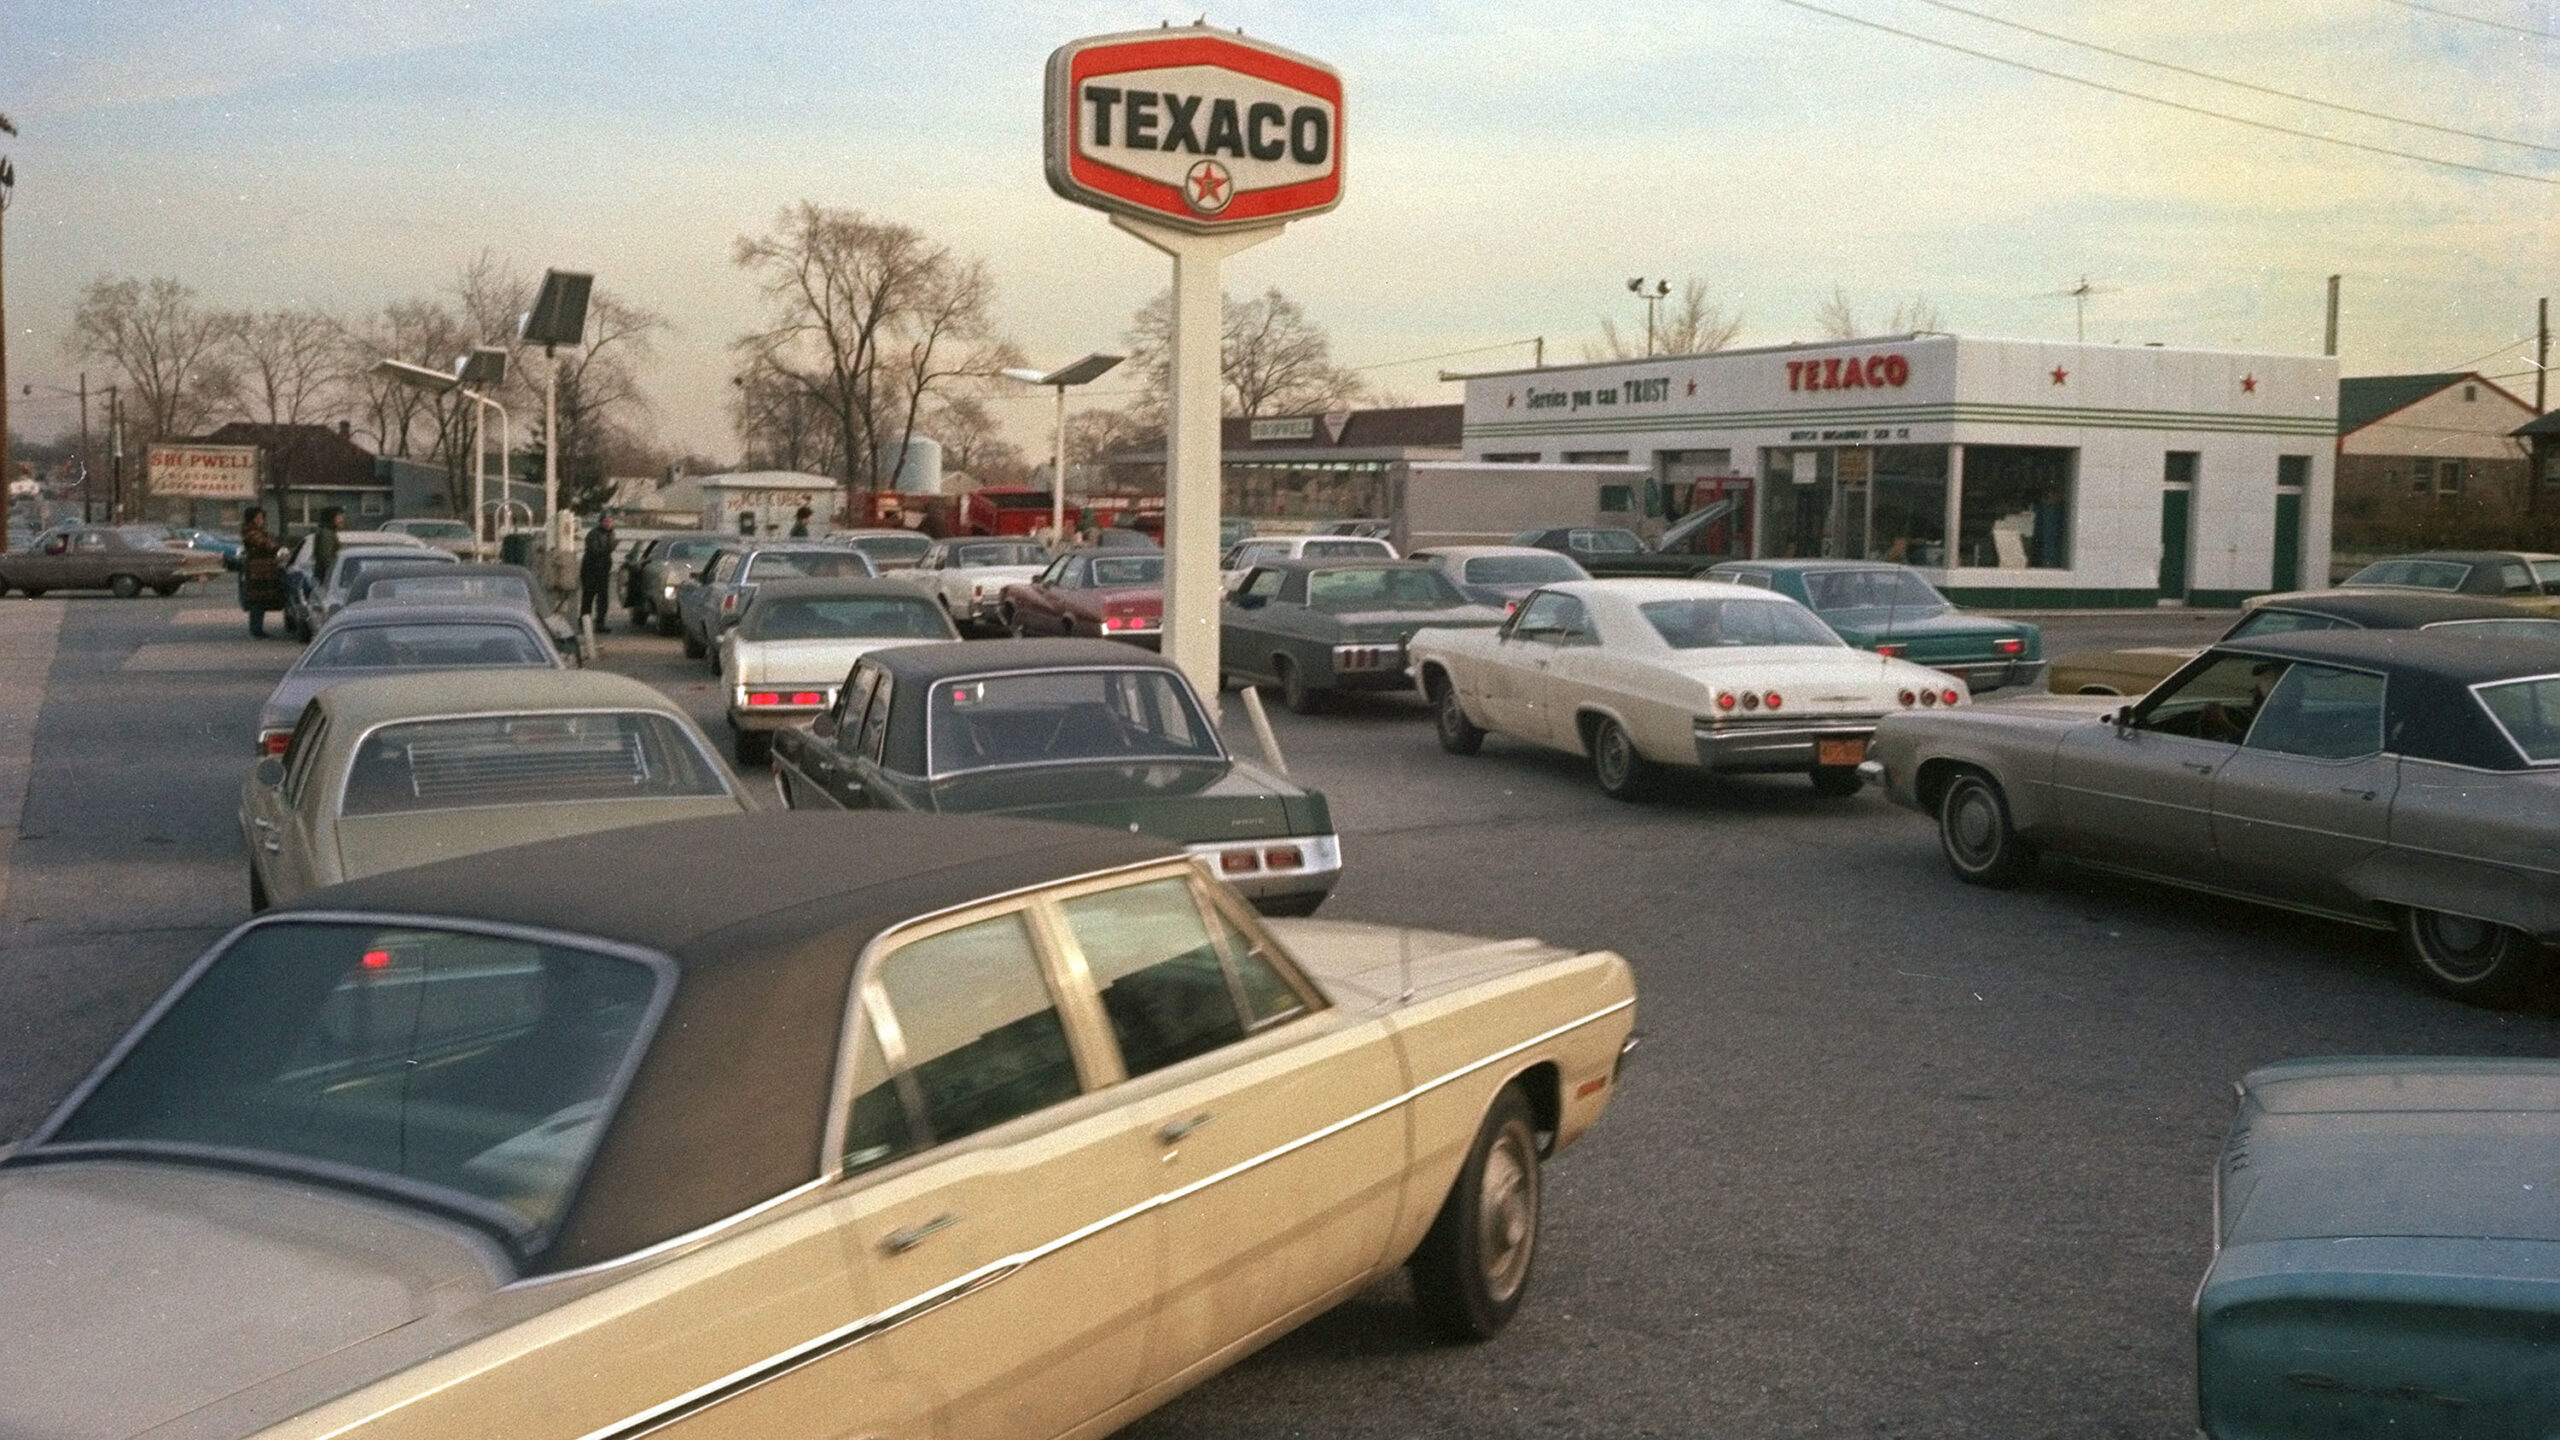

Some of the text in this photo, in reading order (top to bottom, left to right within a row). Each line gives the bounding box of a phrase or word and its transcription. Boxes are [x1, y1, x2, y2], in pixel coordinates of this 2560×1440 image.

[1085, 86, 1329, 165] TEXACO
[1786, 354, 1909, 391] TEXACO
[1526, 377, 1670, 412] Service you can TRUST
